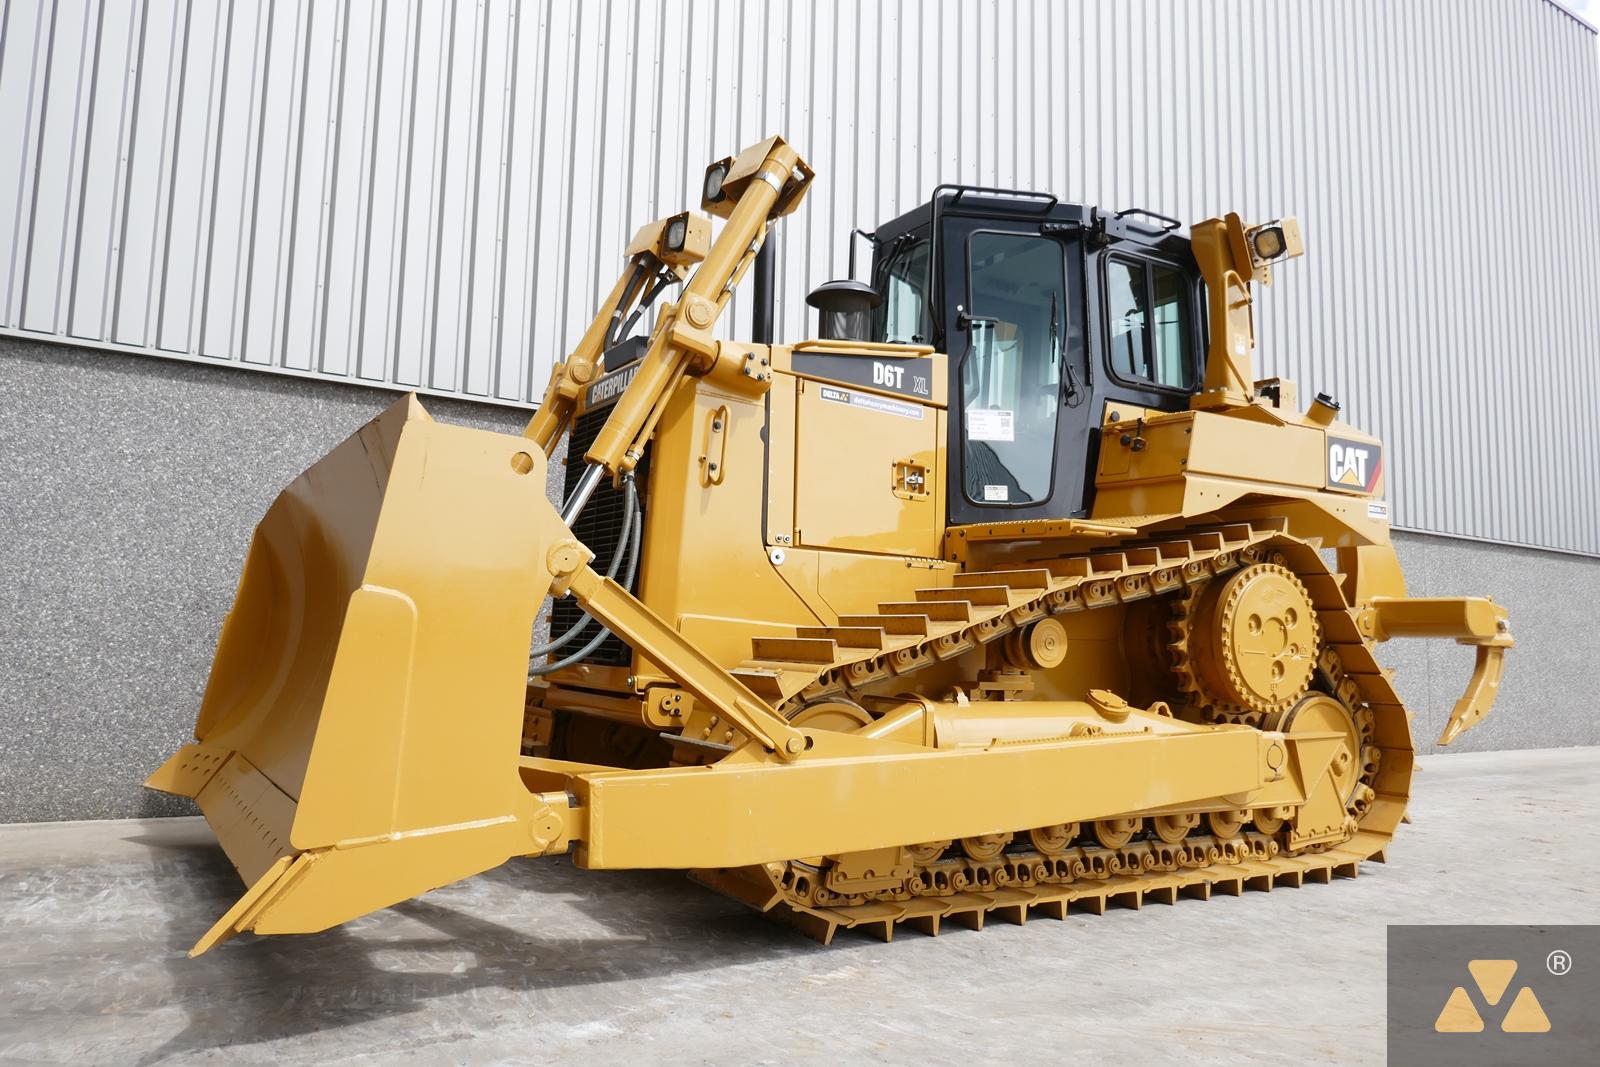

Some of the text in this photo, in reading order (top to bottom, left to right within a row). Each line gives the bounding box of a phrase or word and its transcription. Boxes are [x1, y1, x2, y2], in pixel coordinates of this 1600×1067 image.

[822, 389, 840, 400] DELTA
[873, 361, 929, 395] D6T XL
[1329, 443, 1368, 487] CAT
